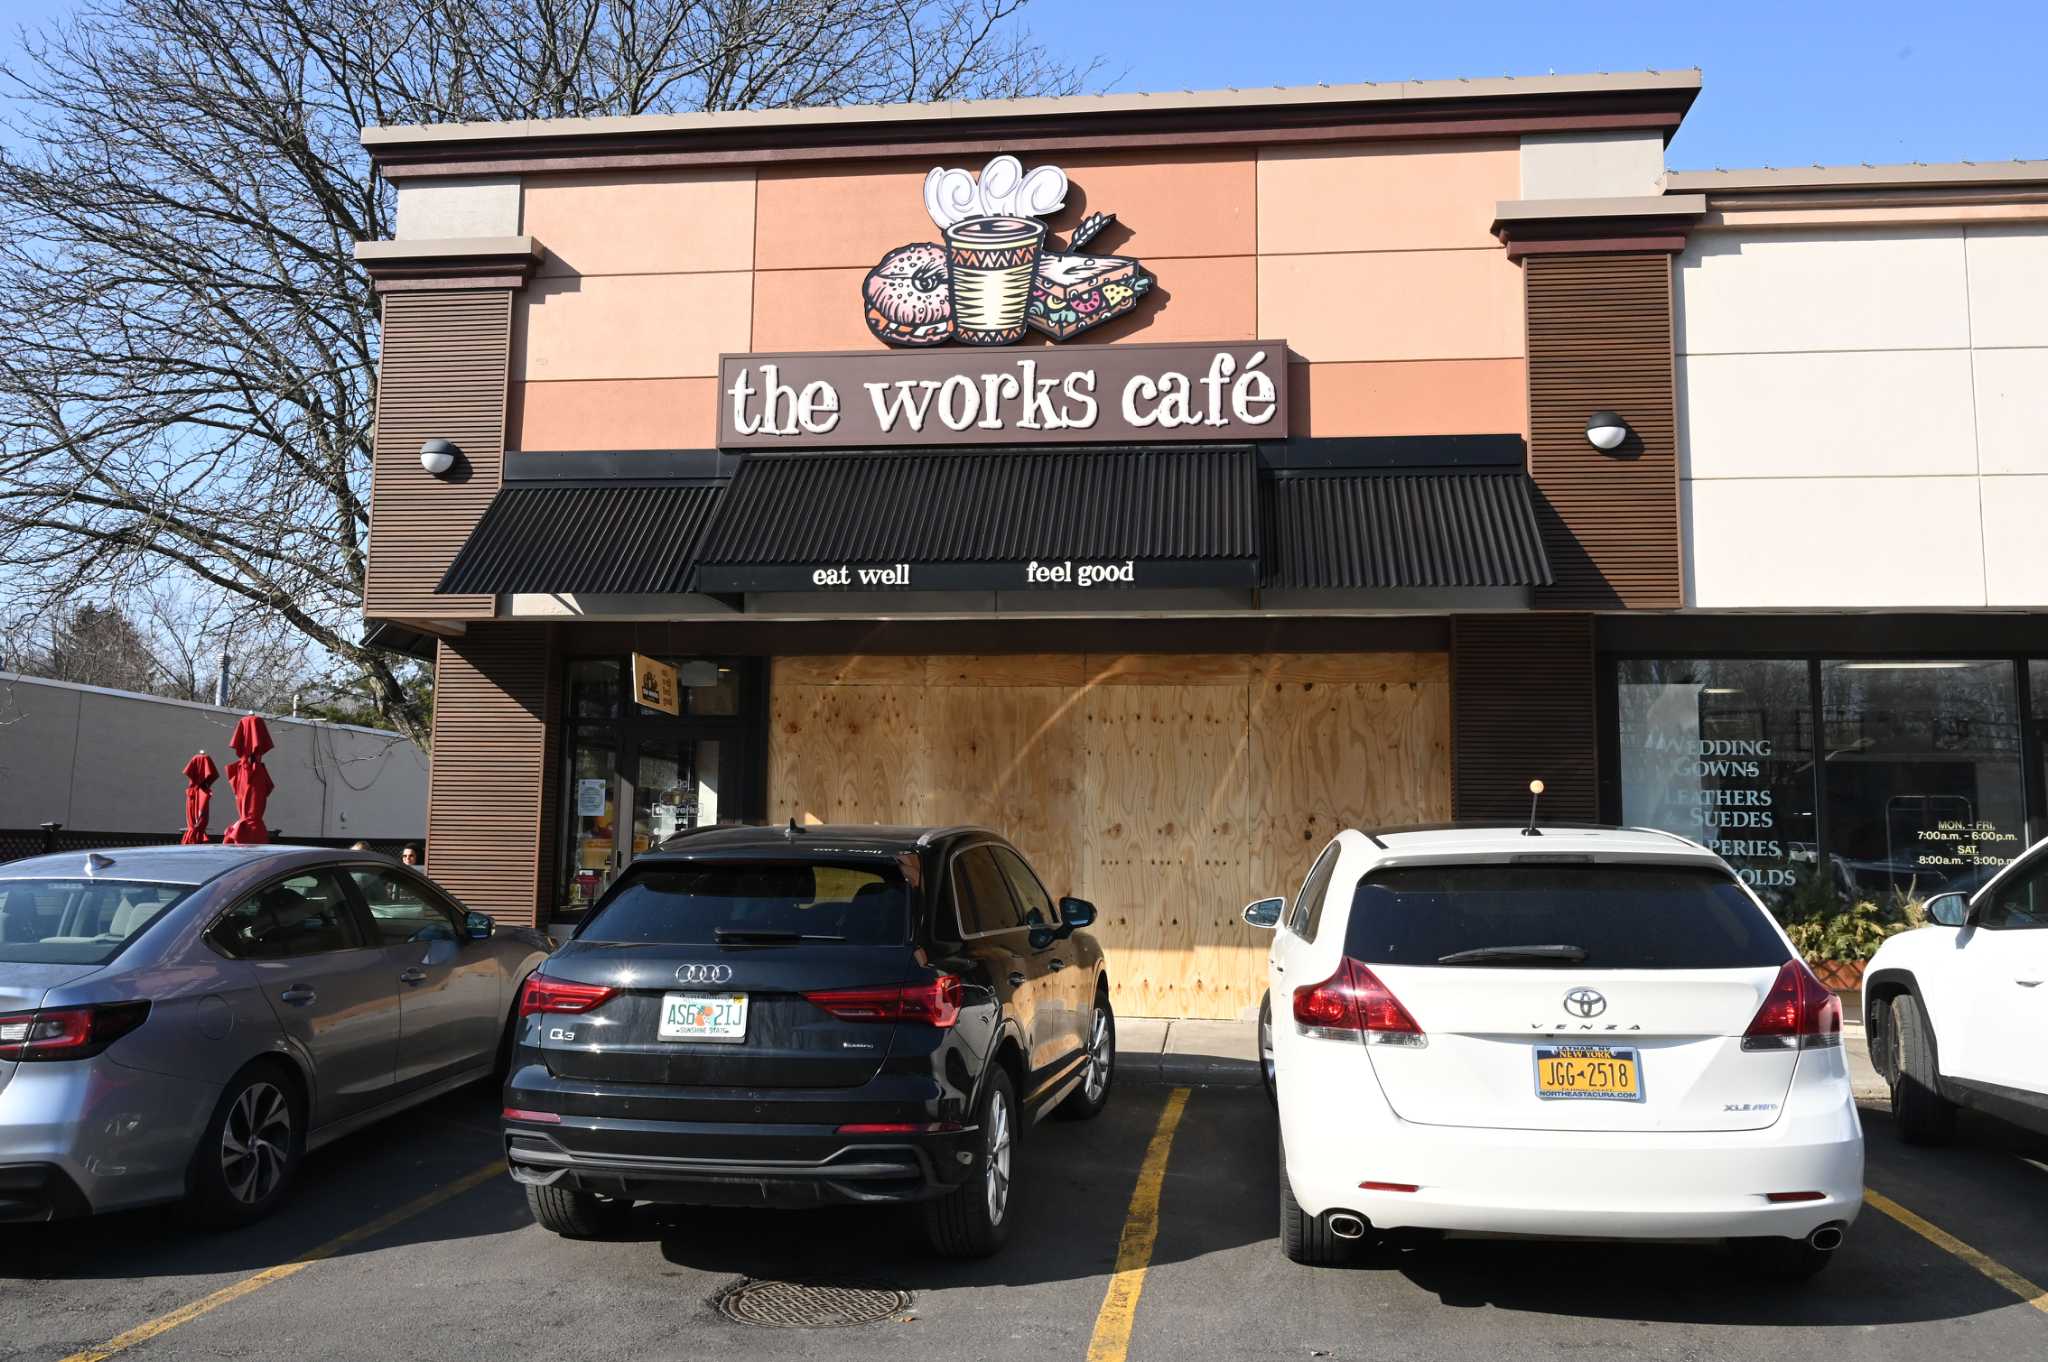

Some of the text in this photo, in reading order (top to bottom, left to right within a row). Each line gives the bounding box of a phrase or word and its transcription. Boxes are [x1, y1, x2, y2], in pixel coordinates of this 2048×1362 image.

[728, 351, 1278, 436] the works café
[812, 564, 910, 585] eat well
[1026, 561, 1135, 586] feel good
[1660, 737, 1772, 756] WEDDING
[1674, 757, 1760, 777] GOWNS
[1664, 787, 1773, 807] LEATHERS
[1690, 808, 1773, 828] SUEDES
[1938, 821, 1966, 831] MON.
[1976, 821, 1996, 831] FRI.
[1917, 831, 1962, 841] 7:00a.m.
[1971, 831, 2018, 842] 6:00p.m.
[1707, 840, 1780, 857] PERIES
[1957, 845, 1980, 855] SAT.
[1919, 856, 1964, 865] 8:00a.m.
[1973, 856, 2016, 866] 3:00p.m
[1735, 868, 1797, 886] OLDS
[550, 1028, 575, 1041] Q3
[1531, 1023, 1641, 1031] VENZA
[1559, 1051, 1611, 1060] NEW YORK
[1547, 1062, 1629, 1088] JGG 2518
